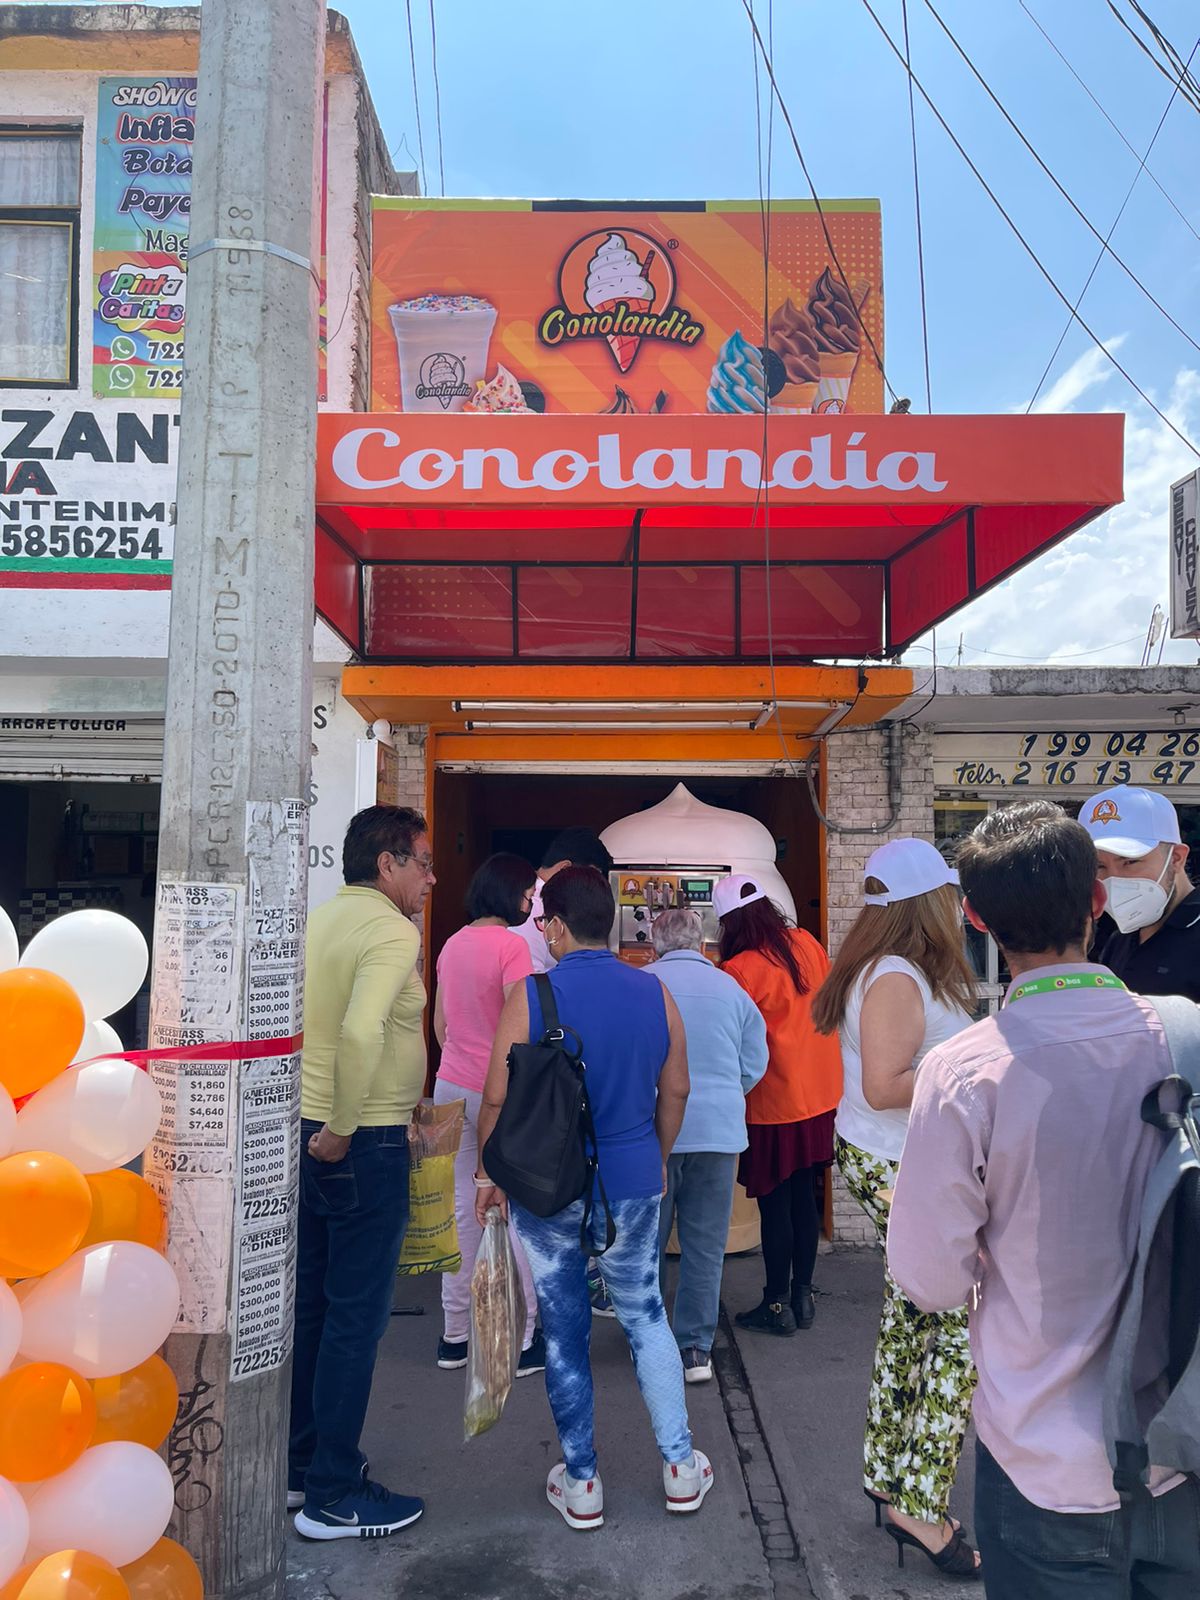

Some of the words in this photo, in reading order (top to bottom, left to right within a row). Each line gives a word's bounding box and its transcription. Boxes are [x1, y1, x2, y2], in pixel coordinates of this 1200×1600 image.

[113, 82, 184, 106] SHOW
[111, 273, 182, 296] Pinta
[102, 298, 184, 321] Caritas
[541, 304, 702, 344] Conolandia
[2, 410, 181, 464] ZAN
[332, 428, 948, 492] Conolandía
[2, 524, 163, 560] 5856254
[1024, 734, 1038, 757] 1
[1047, 732, 1091, 757] 99
[1106, 732, 1147, 756] 04
[1159, 732, 1199, 756] 26
[1012, 761, 1032, 784] 2
[1045, 761, 1077, 784] 16
[1096, 761, 1131, 785] 13
[1153, 760, 1195, 784] 47
[250, 991, 290, 1002] $200,000
[250, 1003, 290, 1014] $300,000
[250, 1016, 290, 1028] $500,000
[250, 1029, 290, 1041] $800,000
[190, 1080, 225, 1090] $1,860
[190, 1094, 225, 1103] $2,786
[189, 1108, 224, 1117] $4,640
[189, 1121, 224, 1130] $7,428
[244, 1135, 285, 1149] $200,000
[244, 1147, 285, 1162] $300,000
[244, 1160, 285, 1176] $500,000
[243, 1173, 284, 1189] $800,000
[240, 1278, 281, 1297] $200,000
[240, 1290, 281, 1310] $300,000
[239, 1304, 280, 1323] $500,000
[239, 1317, 280, 1337] $800,000
